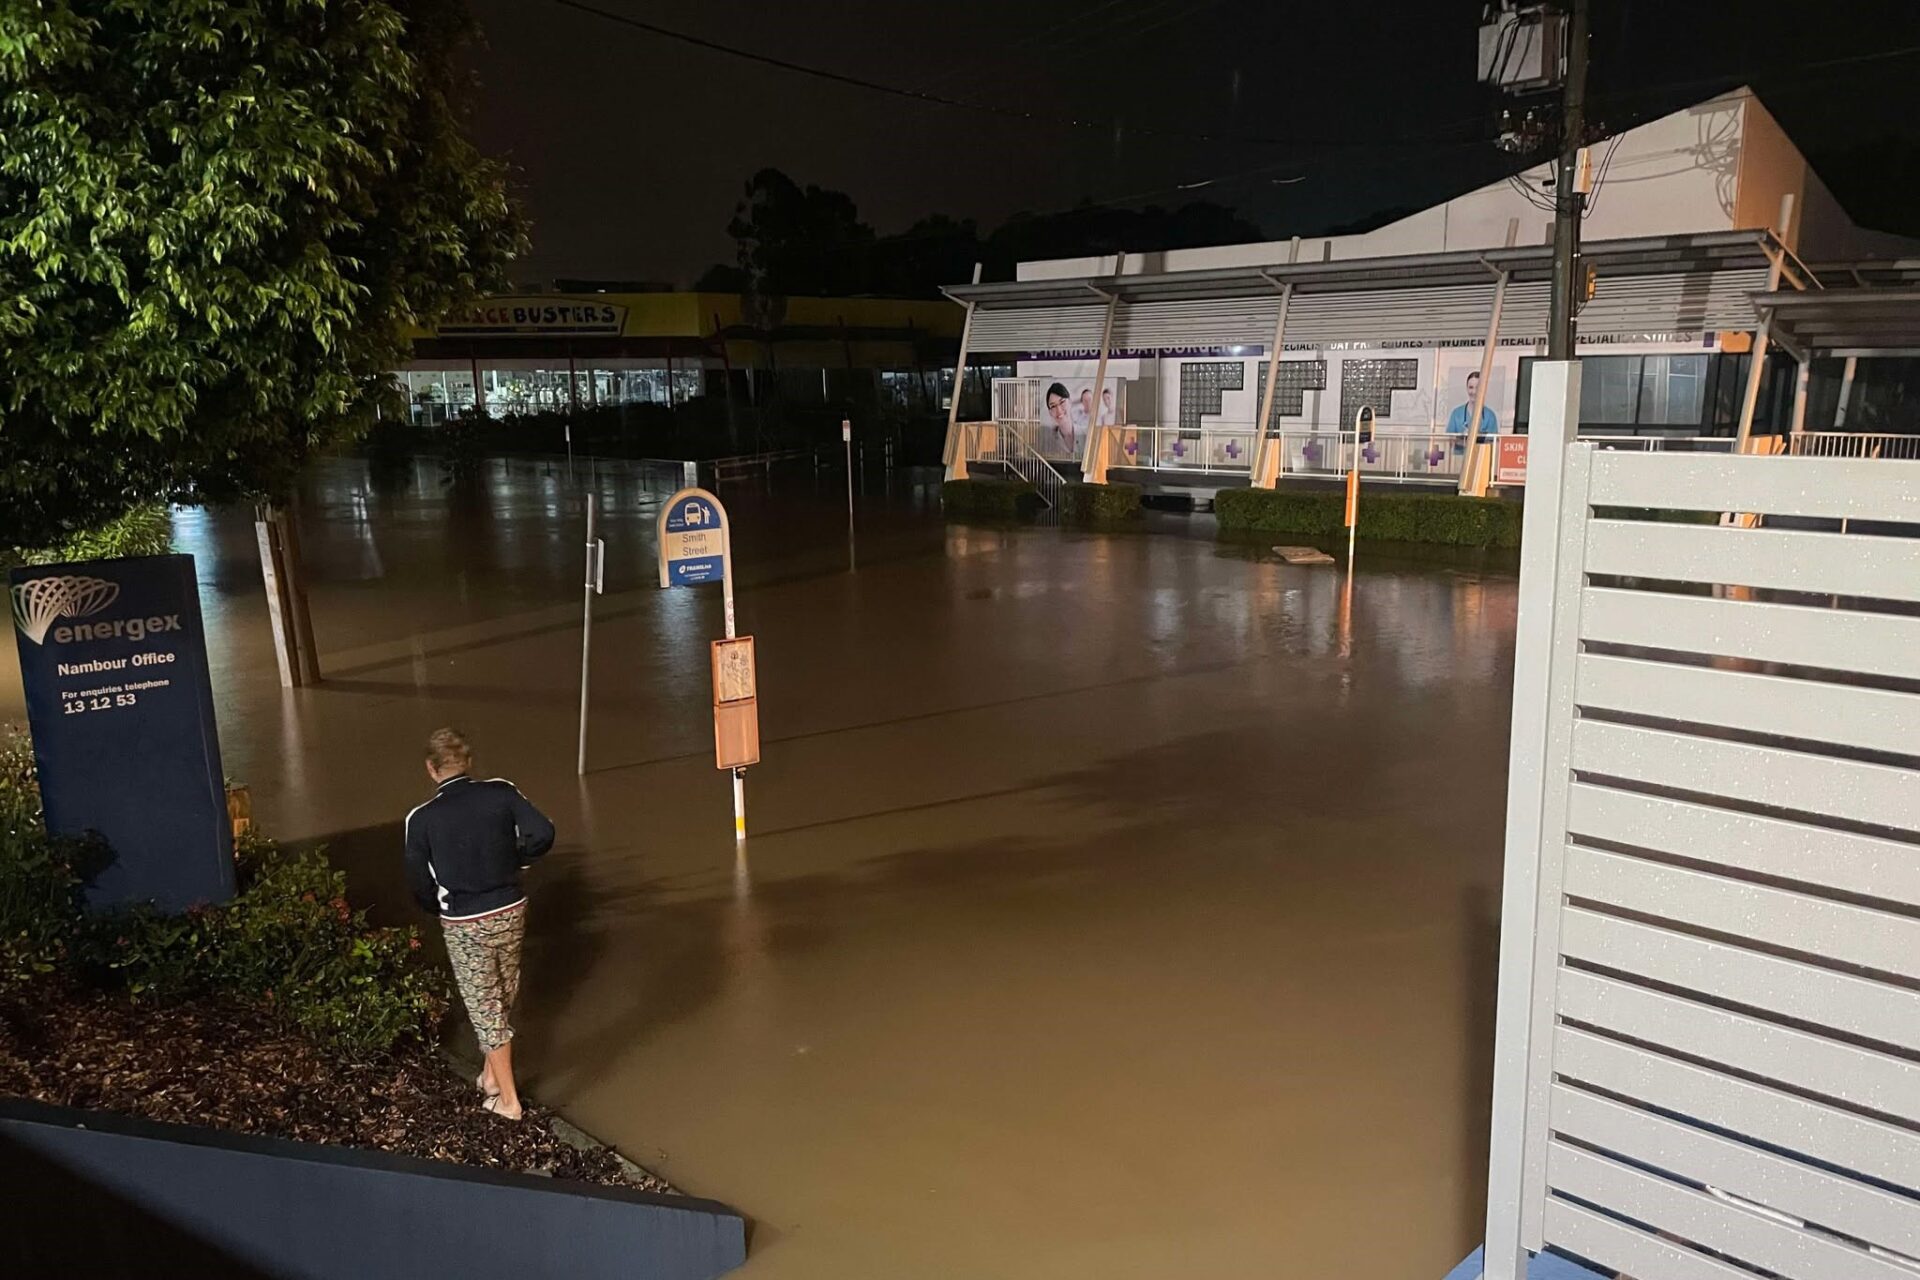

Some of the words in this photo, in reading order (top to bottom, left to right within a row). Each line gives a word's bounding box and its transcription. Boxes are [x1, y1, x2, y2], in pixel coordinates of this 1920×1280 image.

[513, 306, 616, 324] BUSTERS
[1044, 347, 1120, 357] NAMBOR
[1504, 442, 1525, 452] SKIN
[682, 533, 706, 543] Smith
[682, 545, 708, 556] Street
[54, 614, 181, 644] energex
[58, 659, 127, 677] Nambour
[131, 652, 176, 667] Office
[61, 691, 78, 700] For
[80, 685, 122, 697] enquiries
[124, 679, 170, 691] telephone
[64, 701, 85, 714] 13
[90, 697, 111, 710] 12
[116, 693, 136, 706] 53
